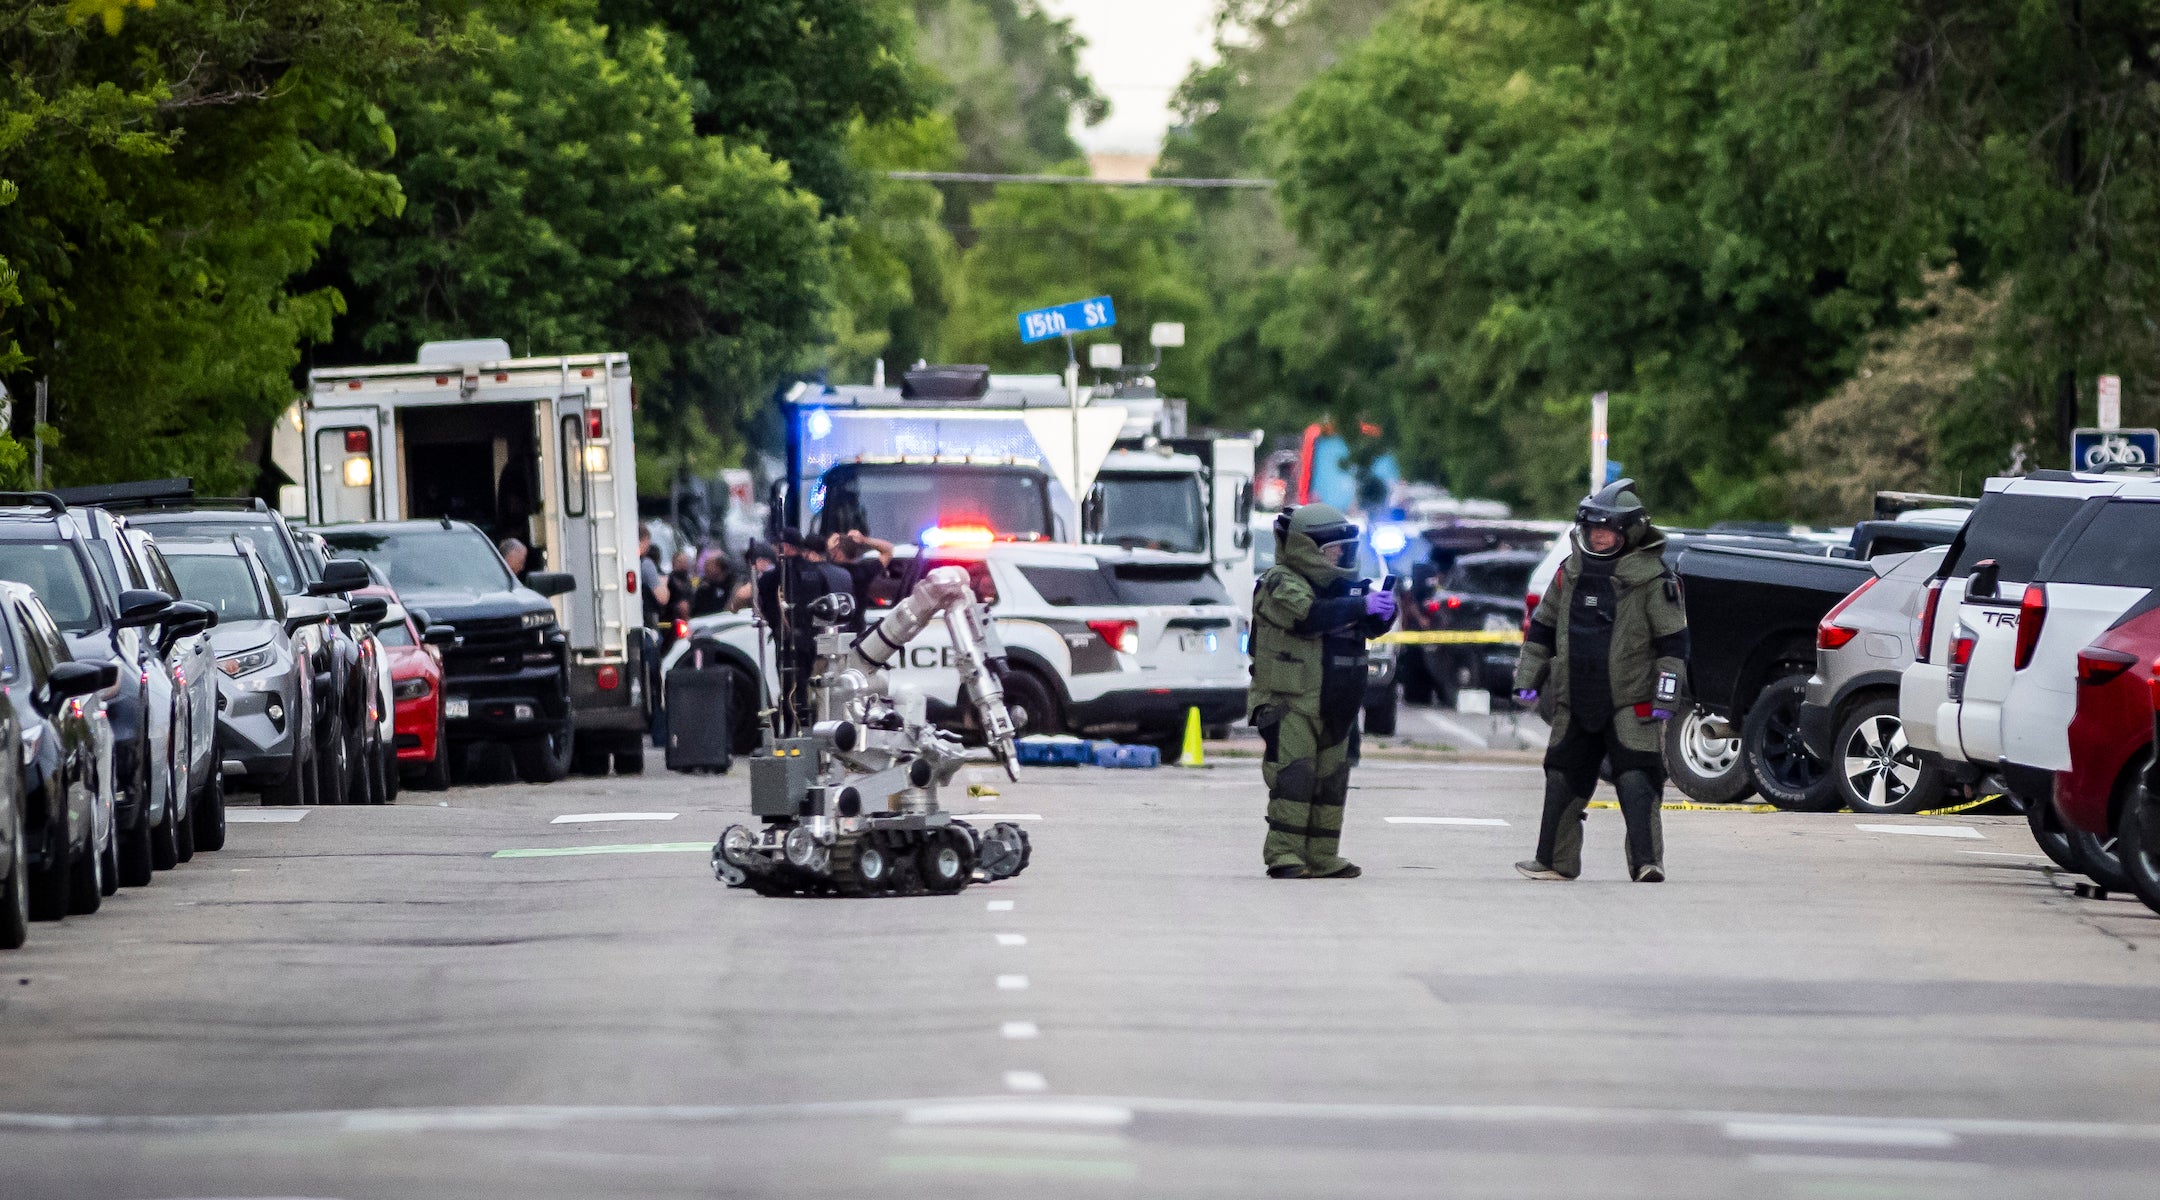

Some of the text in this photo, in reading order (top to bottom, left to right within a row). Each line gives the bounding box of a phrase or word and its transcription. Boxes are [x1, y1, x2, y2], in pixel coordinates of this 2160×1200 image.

[1025, 302, 1107, 338] 15th St
[888, 645, 958, 668] ICE
